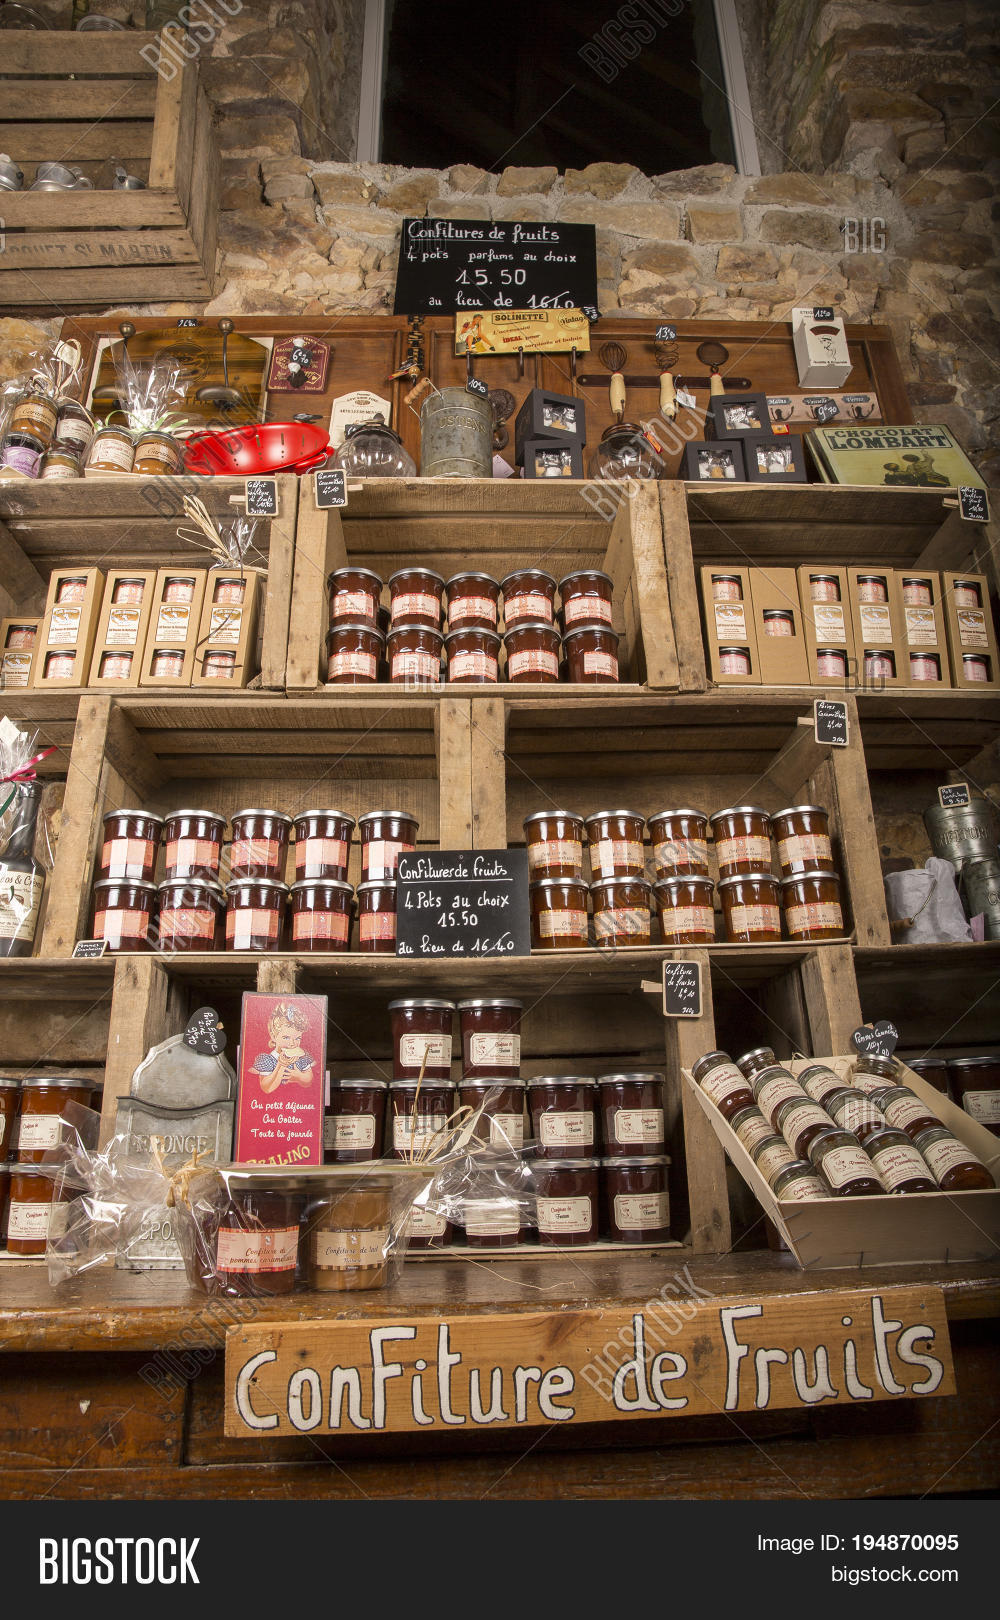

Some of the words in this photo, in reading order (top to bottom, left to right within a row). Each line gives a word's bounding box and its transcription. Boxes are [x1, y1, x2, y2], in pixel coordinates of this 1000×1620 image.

[489, 226, 506, 240] de
[512, 224, 560, 243] fruits
[100, 245, 172, 259] MARTIN
[407, 246, 418, 262] 4
[422, 250, 449, 263] pots
[469, 249, 514, 262] parfums
[523, 252, 538, 262] au
[544, 251, 577, 263] choix
[429, 297, 442, 306] au
[456, 291, 483, 306] lieu
[494, 292, 513, 307] de
[494, 313, 544, 323] SOLINETTE
[835, 428, 932, 437] CHOCOLAT
[829, 435, 950, 450] LOMBART
[399, 857, 452, 879] Confitures
[454, 863, 468, 877] de
[473, 856, 508, 877] fruits
[405, 890, 413, 909] 4
[416, 890, 441, 908] Pots
[452, 895, 470, 908] au
[477, 890, 509, 907] choix
[398, 942, 414, 954] au
[420, 935, 445, 952] lieu
[452, 940, 464, 952] de
[251, 1099, 264, 1109] Au
[265, 1099, 283, 1110] petit
[286, 1100, 315, 1114] déjeuner
[263, 1114, 275, 1124] Au
[277, 1113, 303, 1124] Goûter
[251, 1129, 274, 1138] Toute
[277, 1129, 286, 1138] la
[287, 1129, 314, 1142] journée
[141, 1221, 176, 1240] EPO
[245, 1247, 277, 1257] Confiture
[613, 1314, 688, 1411] de
[719, 1296, 944, 1411] Fruits
